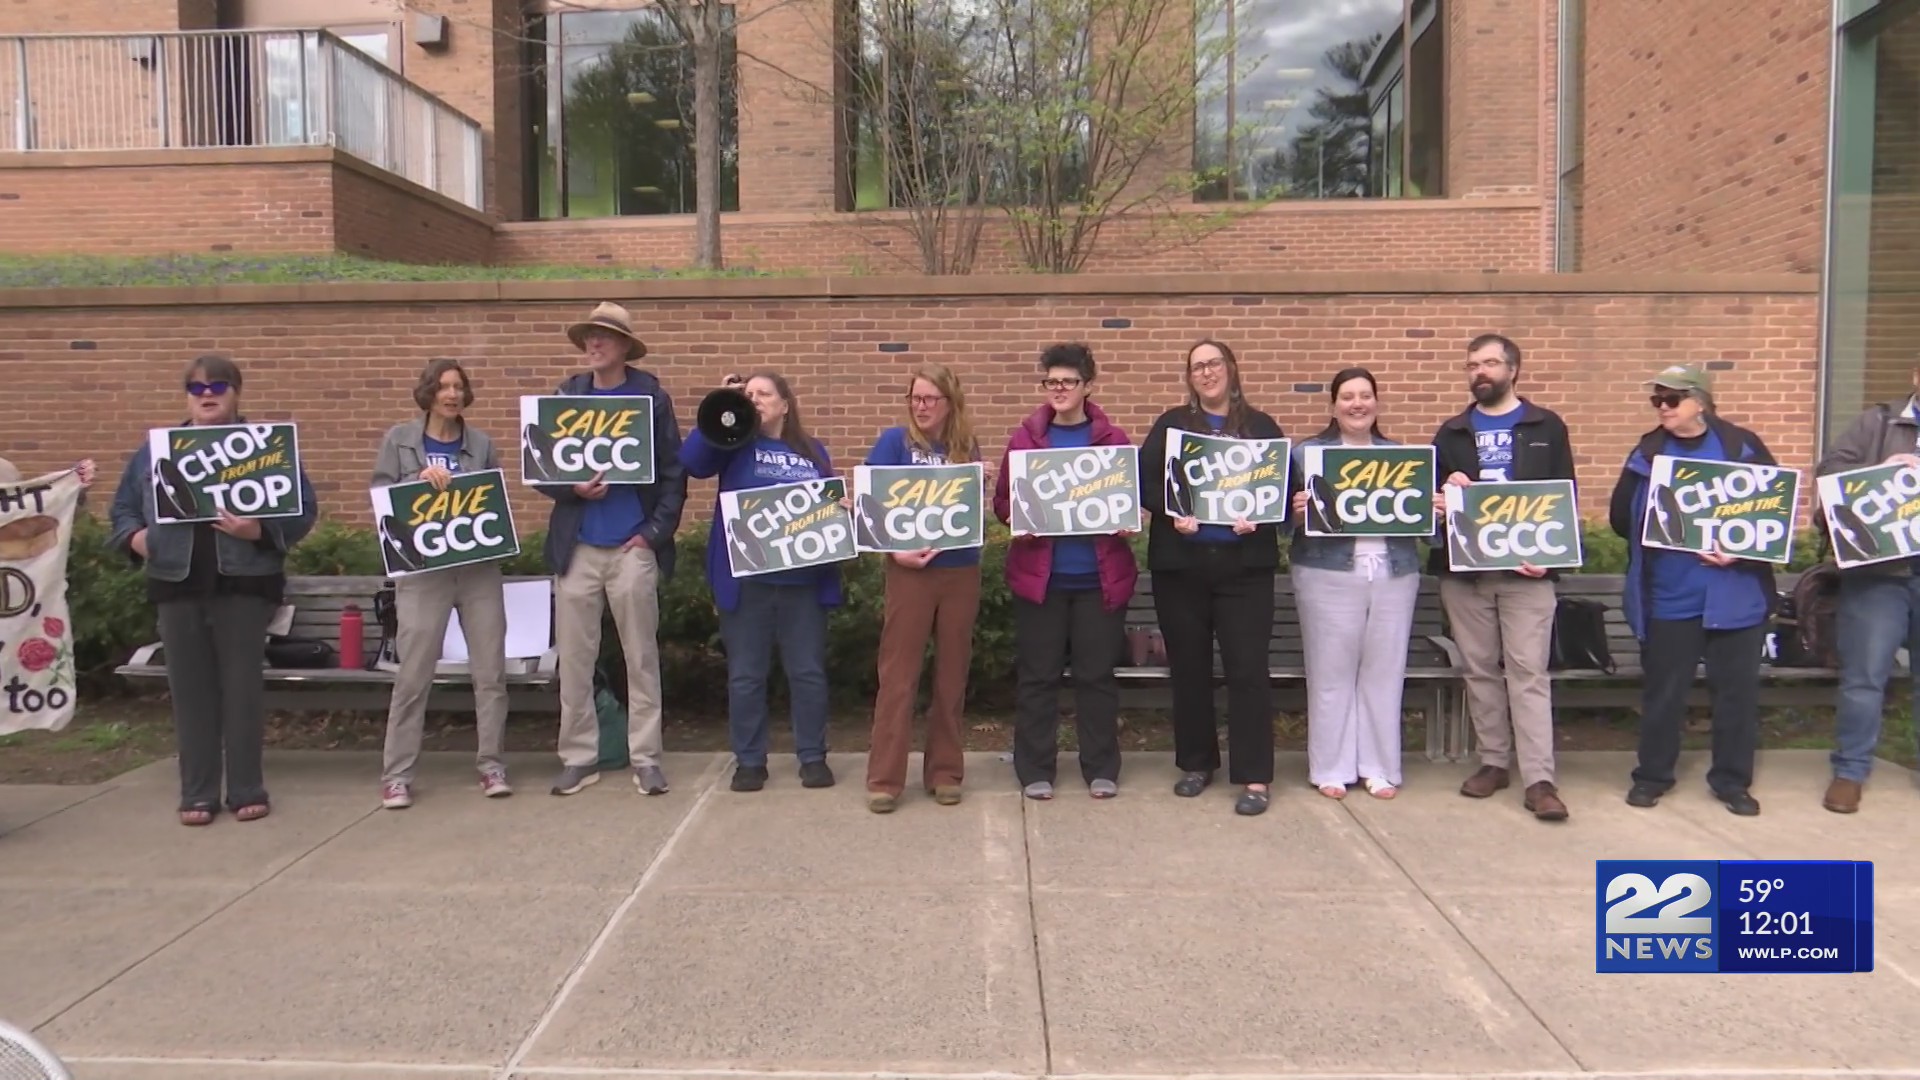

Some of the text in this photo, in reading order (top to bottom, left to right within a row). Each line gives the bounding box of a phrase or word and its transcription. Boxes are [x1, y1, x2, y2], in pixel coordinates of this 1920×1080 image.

[550, 409, 642, 438] SAVE
[177, 425, 274, 483] CHOP
[220, 450, 284, 482] FROM THE
[552, 437, 641, 472] GCC
[1184, 440, 1270, 486] CHOP
[1033, 447, 1117, 500] CHOP
[1068, 470, 1127, 501] FROM THE
[1334, 459, 1425, 489] SAVE
[1674, 466, 1779, 514] CHOP
[203, 475, 292, 516] TOP
[408, 484, 495, 526] SAVE
[747, 481, 825, 538] CHOP
[882, 478, 972, 508] SAVE
[1200, 485, 1280, 520] TOP
[1335, 488, 1423, 524] GCC
[1475, 493, 1564, 525] SAVE
[1713, 500, 1755, 518] FROM
[784, 502, 838, 536] FROM THE
[884, 503, 970, 540] GCC
[1052, 493, 1133, 532] TOP
[413, 512, 504, 557] GCC
[769, 523, 847, 567] TOP
[1478, 521, 1568, 558] GCC
[1693, 518, 1785, 552] TOP
[4, 675, 68, 713] too
